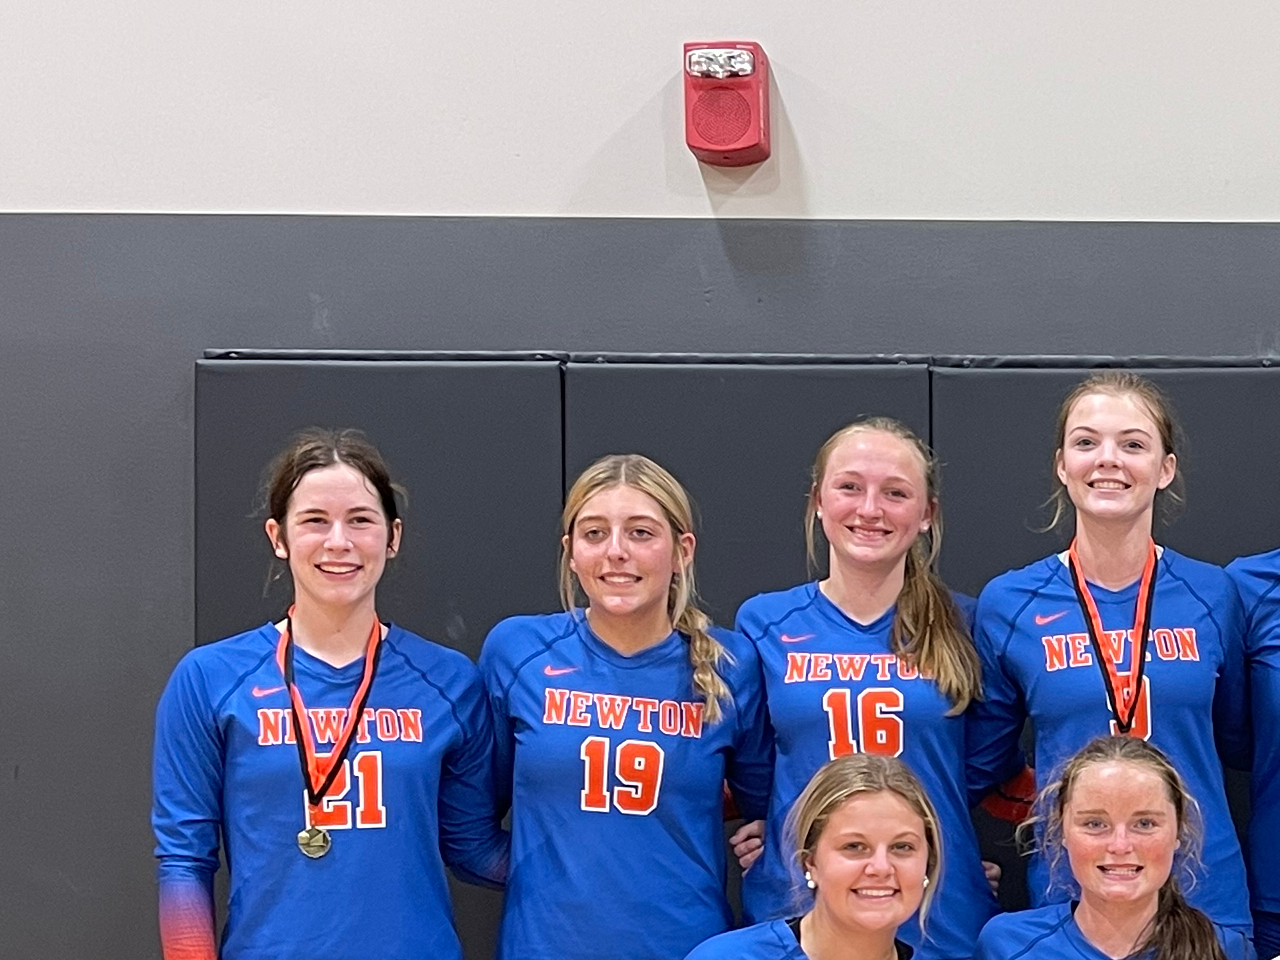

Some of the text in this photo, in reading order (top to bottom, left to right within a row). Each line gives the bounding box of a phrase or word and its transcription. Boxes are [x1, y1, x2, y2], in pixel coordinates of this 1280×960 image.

[784, 652, 937, 682] NEWTO
[543, 688, 705, 738] NEWTON
[822, 687, 904, 761] 16
[302, 750, 387, 829] 21
[580, 736, 665, 816] 19
